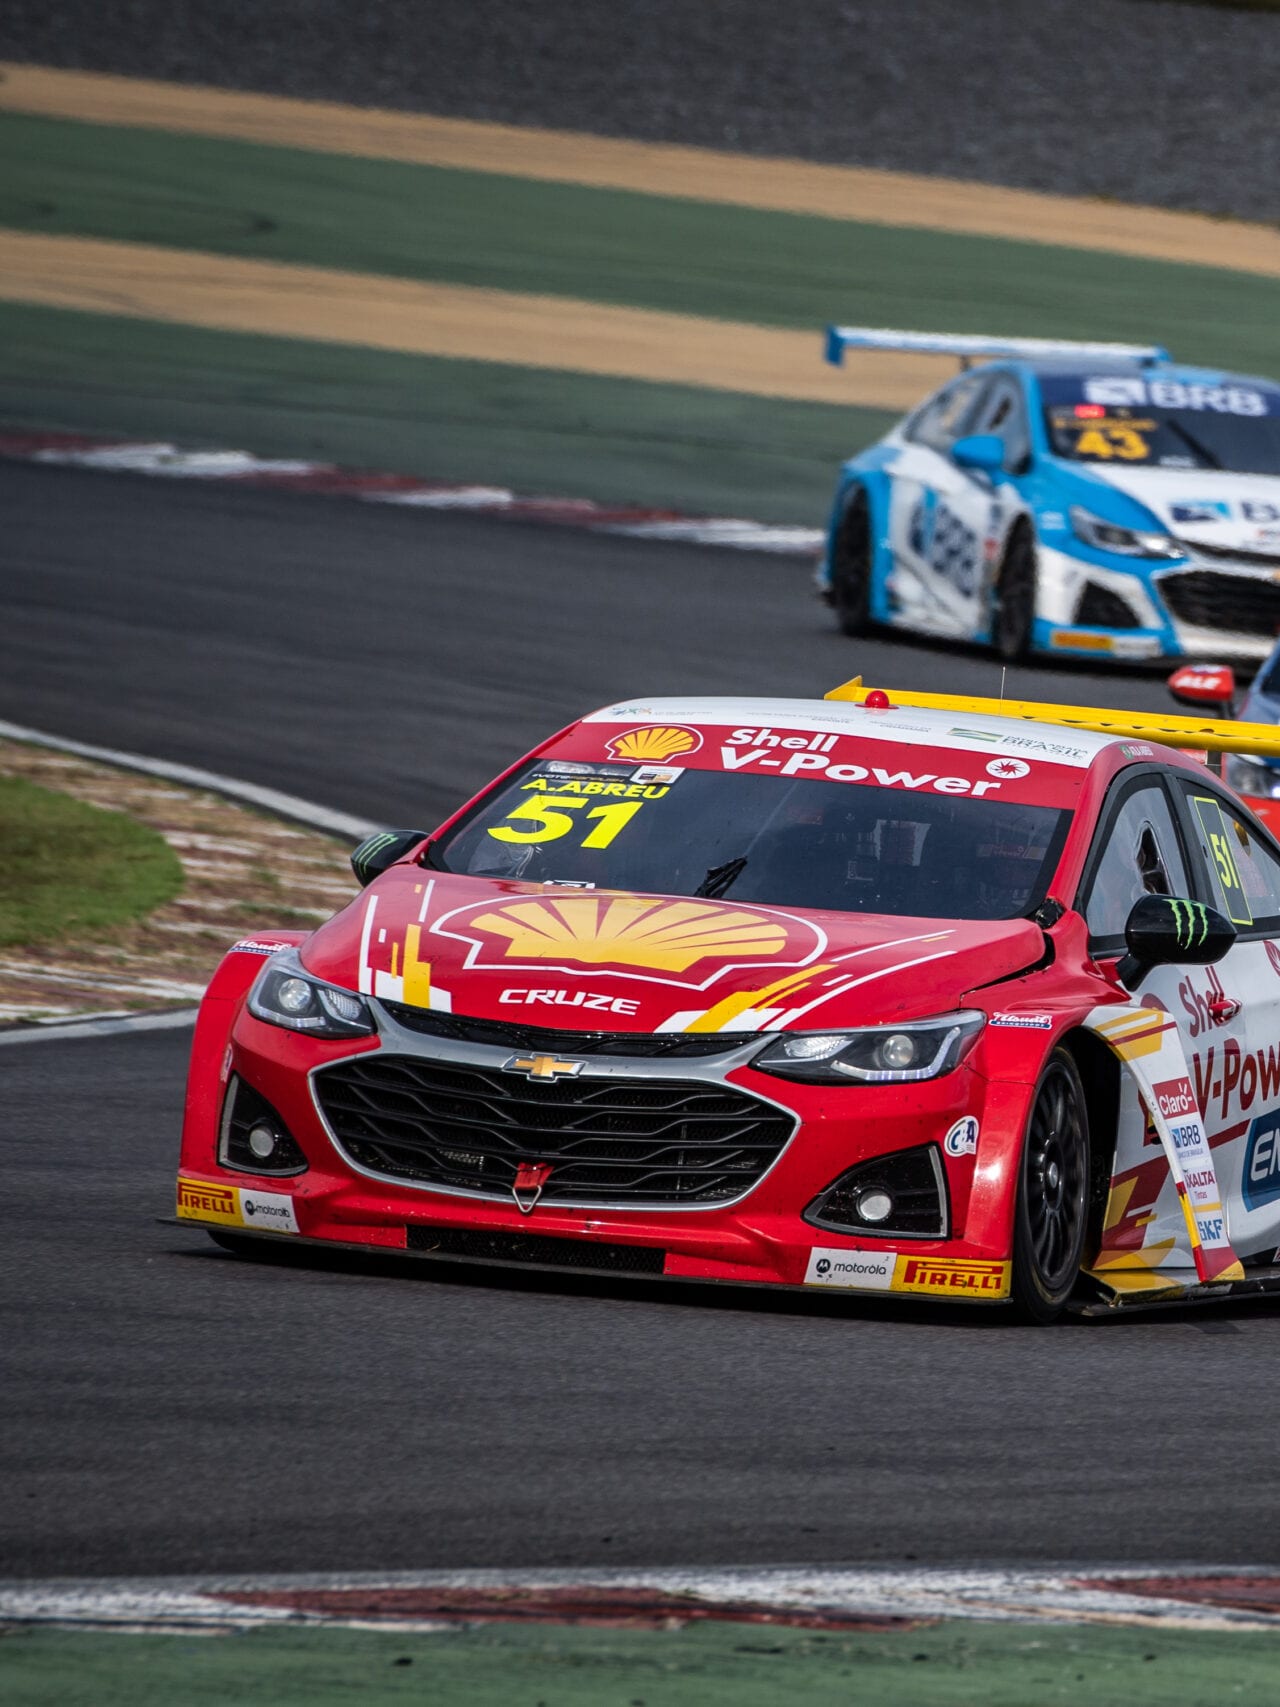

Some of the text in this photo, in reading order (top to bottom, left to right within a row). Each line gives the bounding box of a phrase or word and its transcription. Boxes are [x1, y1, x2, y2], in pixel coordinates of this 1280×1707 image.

[1151, 381, 1268, 416] BRB
[1076, 430, 1149, 460] 43
[725, 728, 839, 752] Shell
[720, 746, 1001, 796] V-Power
[521, 778, 671, 799] A.ABREU
[487, 794, 644, 849] 51
[1210, 833, 1239, 889] 51
[499, 988, 641, 1015] CRUZE
[1158, 1094, 1189, 1115] Claro
[1180, 1124, 1201, 1147] BRB
[178, 1182, 235, 1215] PIRELLI
[255, 1203, 290, 1218] motorola
[1197, 1218, 1223, 1241] SKF
[834, 1261, 887, 1275] motorola
[903, 1260, 1004, 1290] PIRELLI
